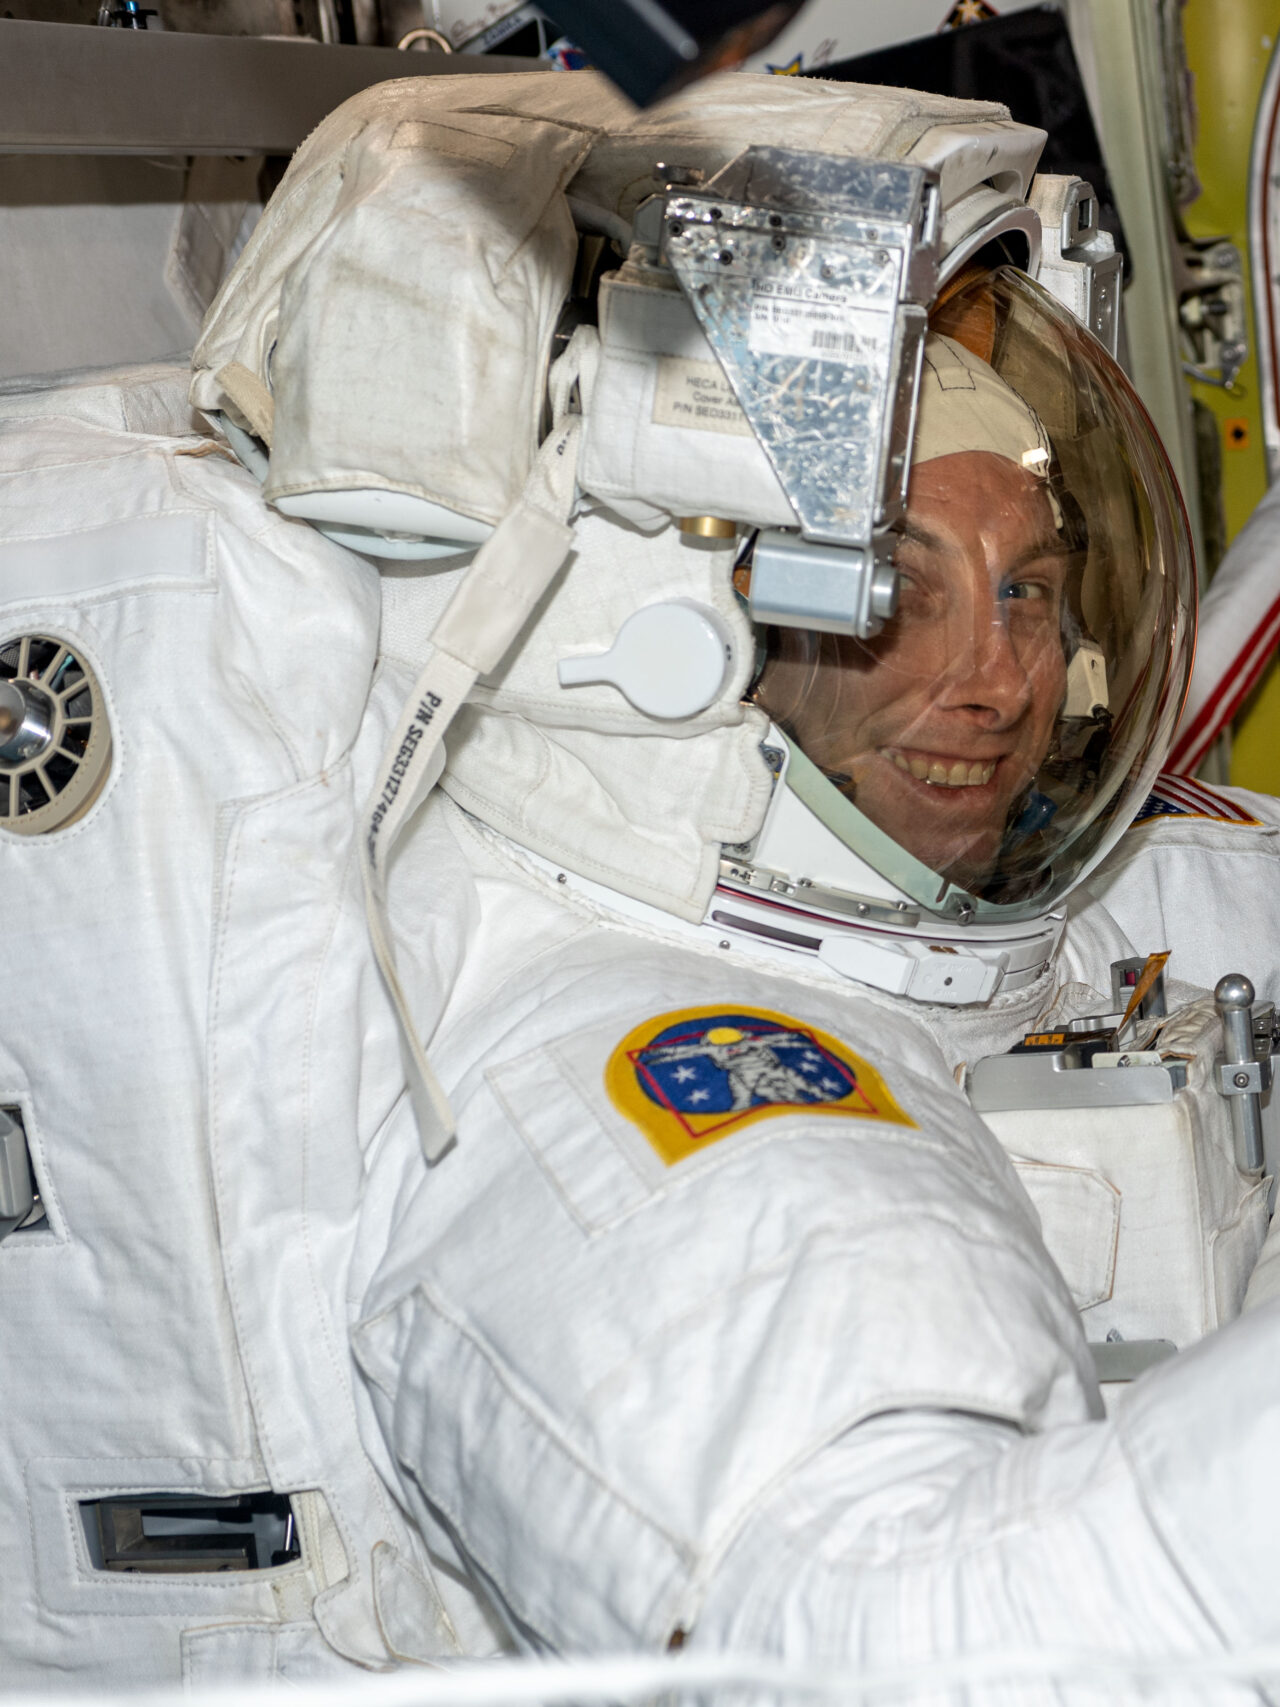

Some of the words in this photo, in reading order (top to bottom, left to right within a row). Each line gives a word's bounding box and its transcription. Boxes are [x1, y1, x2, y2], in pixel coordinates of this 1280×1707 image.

[776, 286, 802, 298] EMU
[804, 287, 848, 303] Camera
[686, 375, 717, 390] HECA
[692, 390, 723, 404] Cover
[411, 690, 443, 726] P/N
